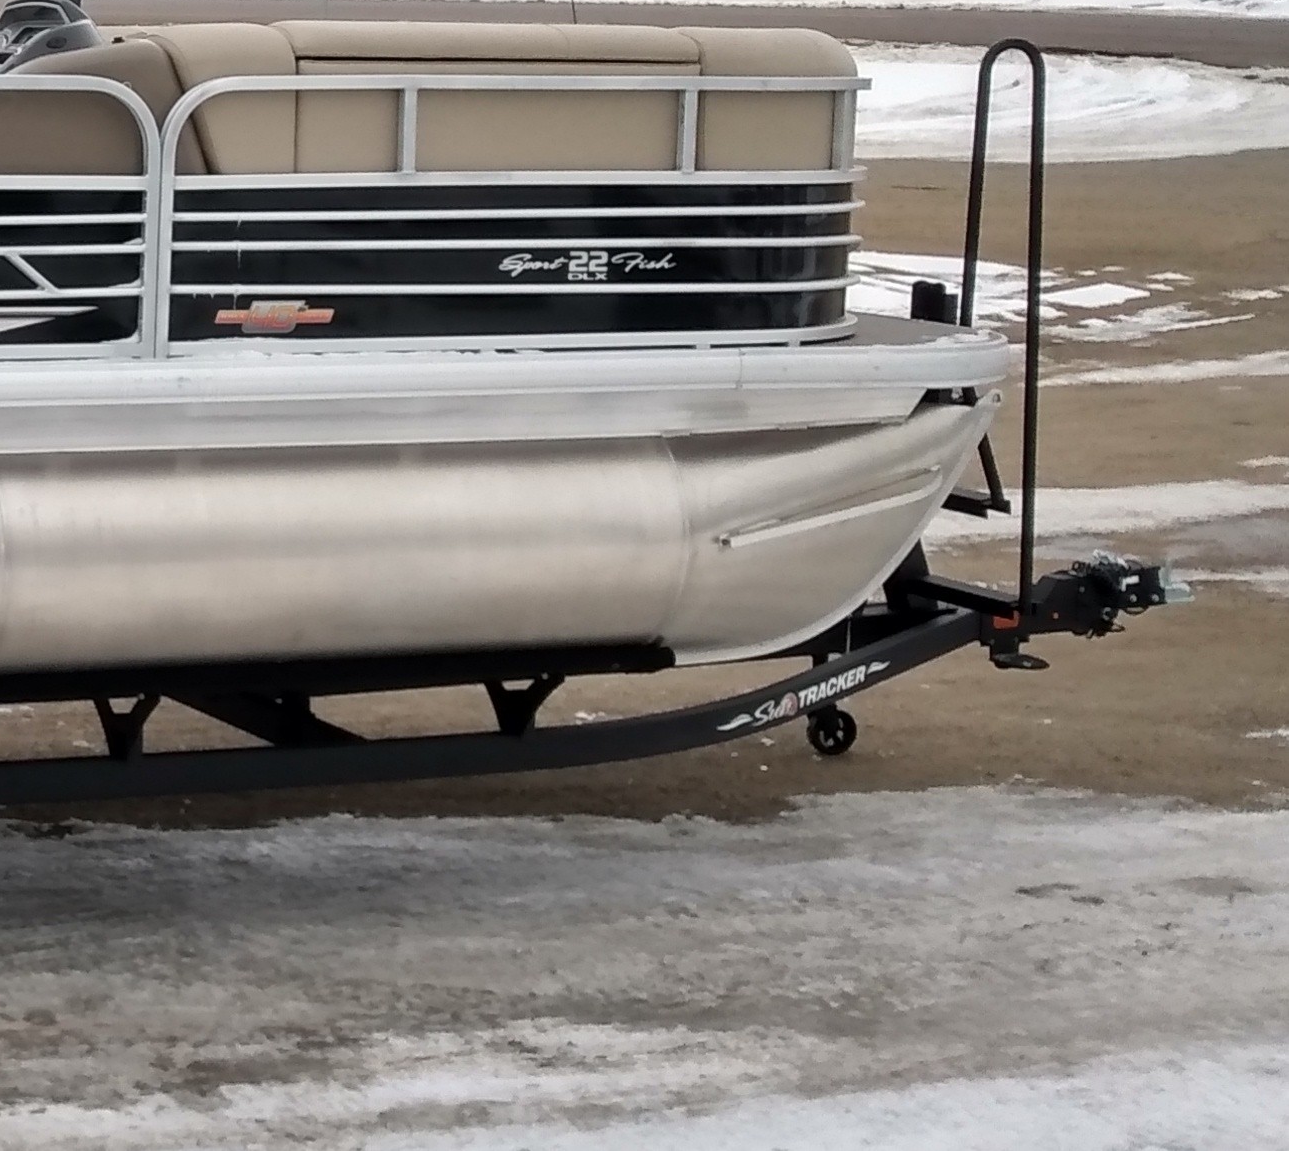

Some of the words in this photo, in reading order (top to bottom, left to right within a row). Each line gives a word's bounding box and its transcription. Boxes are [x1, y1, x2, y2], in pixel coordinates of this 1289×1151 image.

[498, 253, 568, 277] Sport
[568, 251, 608, 272] 22
[611, 252, 677, 273] Fish
[798, 664, 867, 708] TRACKER
